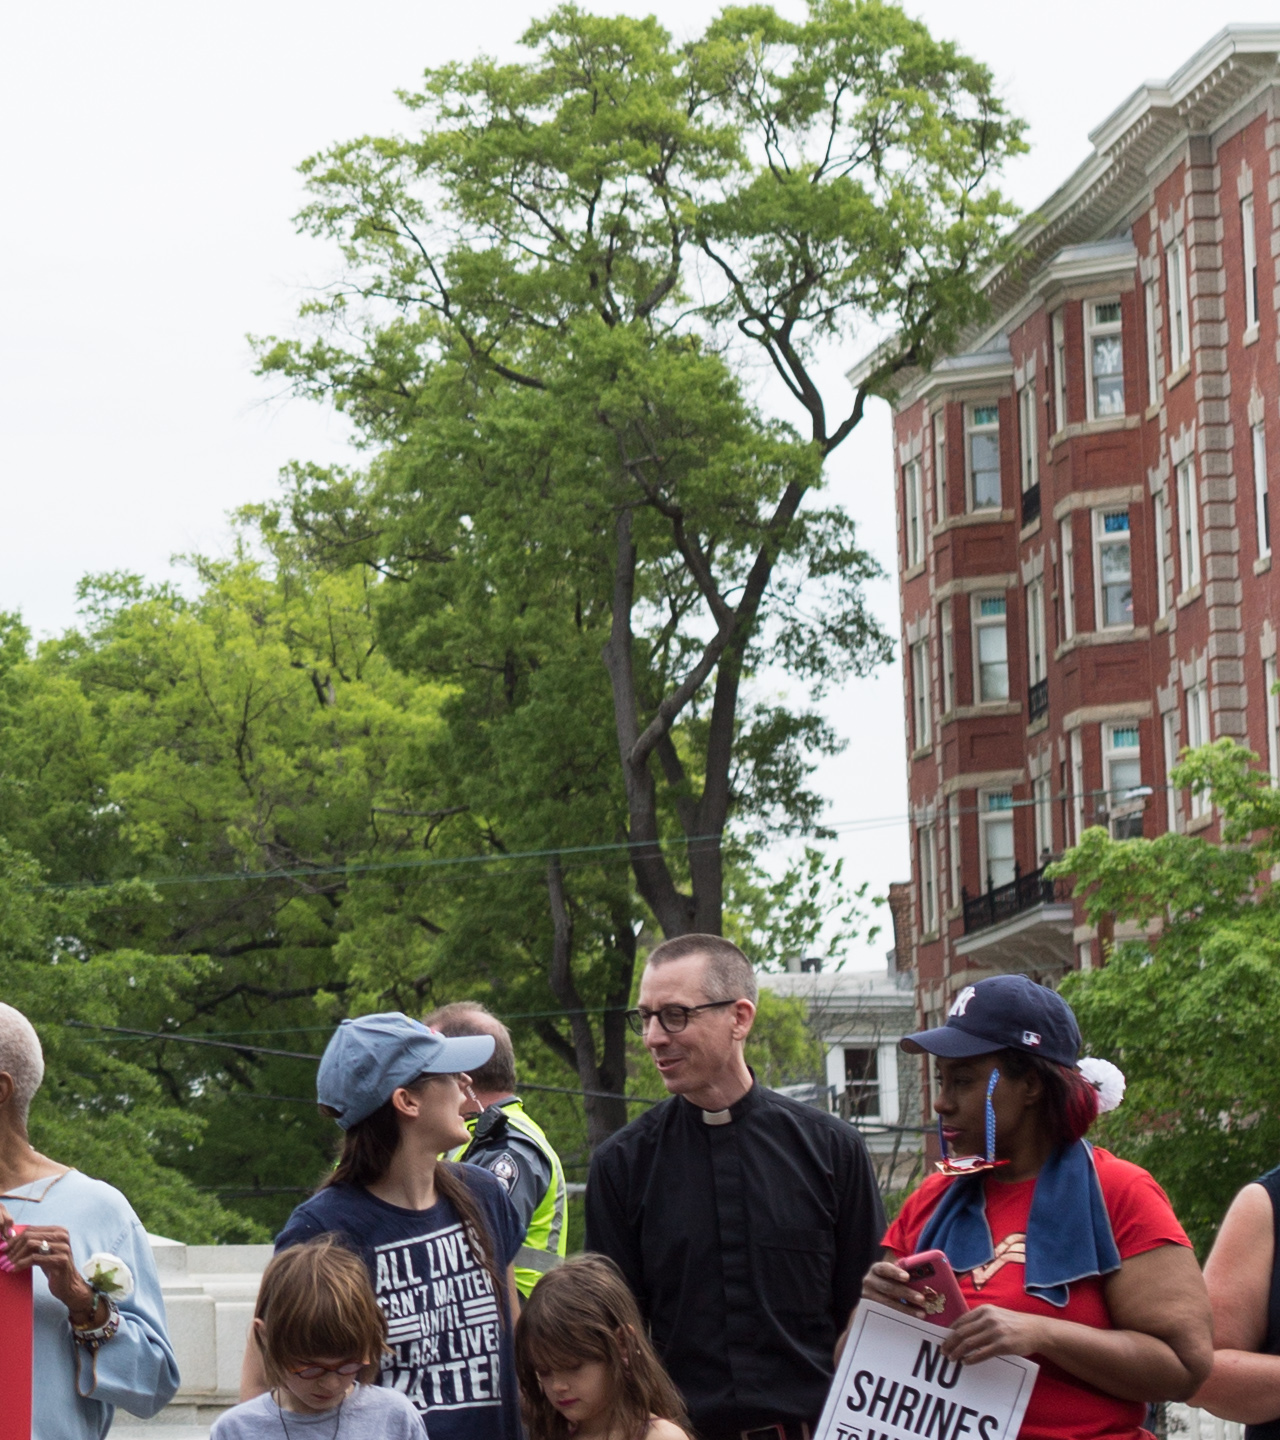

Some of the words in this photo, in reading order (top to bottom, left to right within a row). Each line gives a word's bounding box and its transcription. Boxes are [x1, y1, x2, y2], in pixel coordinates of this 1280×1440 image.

[375, 1247, 423, 1295] ALL
[425, 1227, 487, 1279] LIVES
[376, 1285, 429, 1319] CAN'T
[420, 1304, 466, 1337] UNTIL
[381, 1335, 441, 1371] BLACK
[911, 1339, 964, 1390] NO
